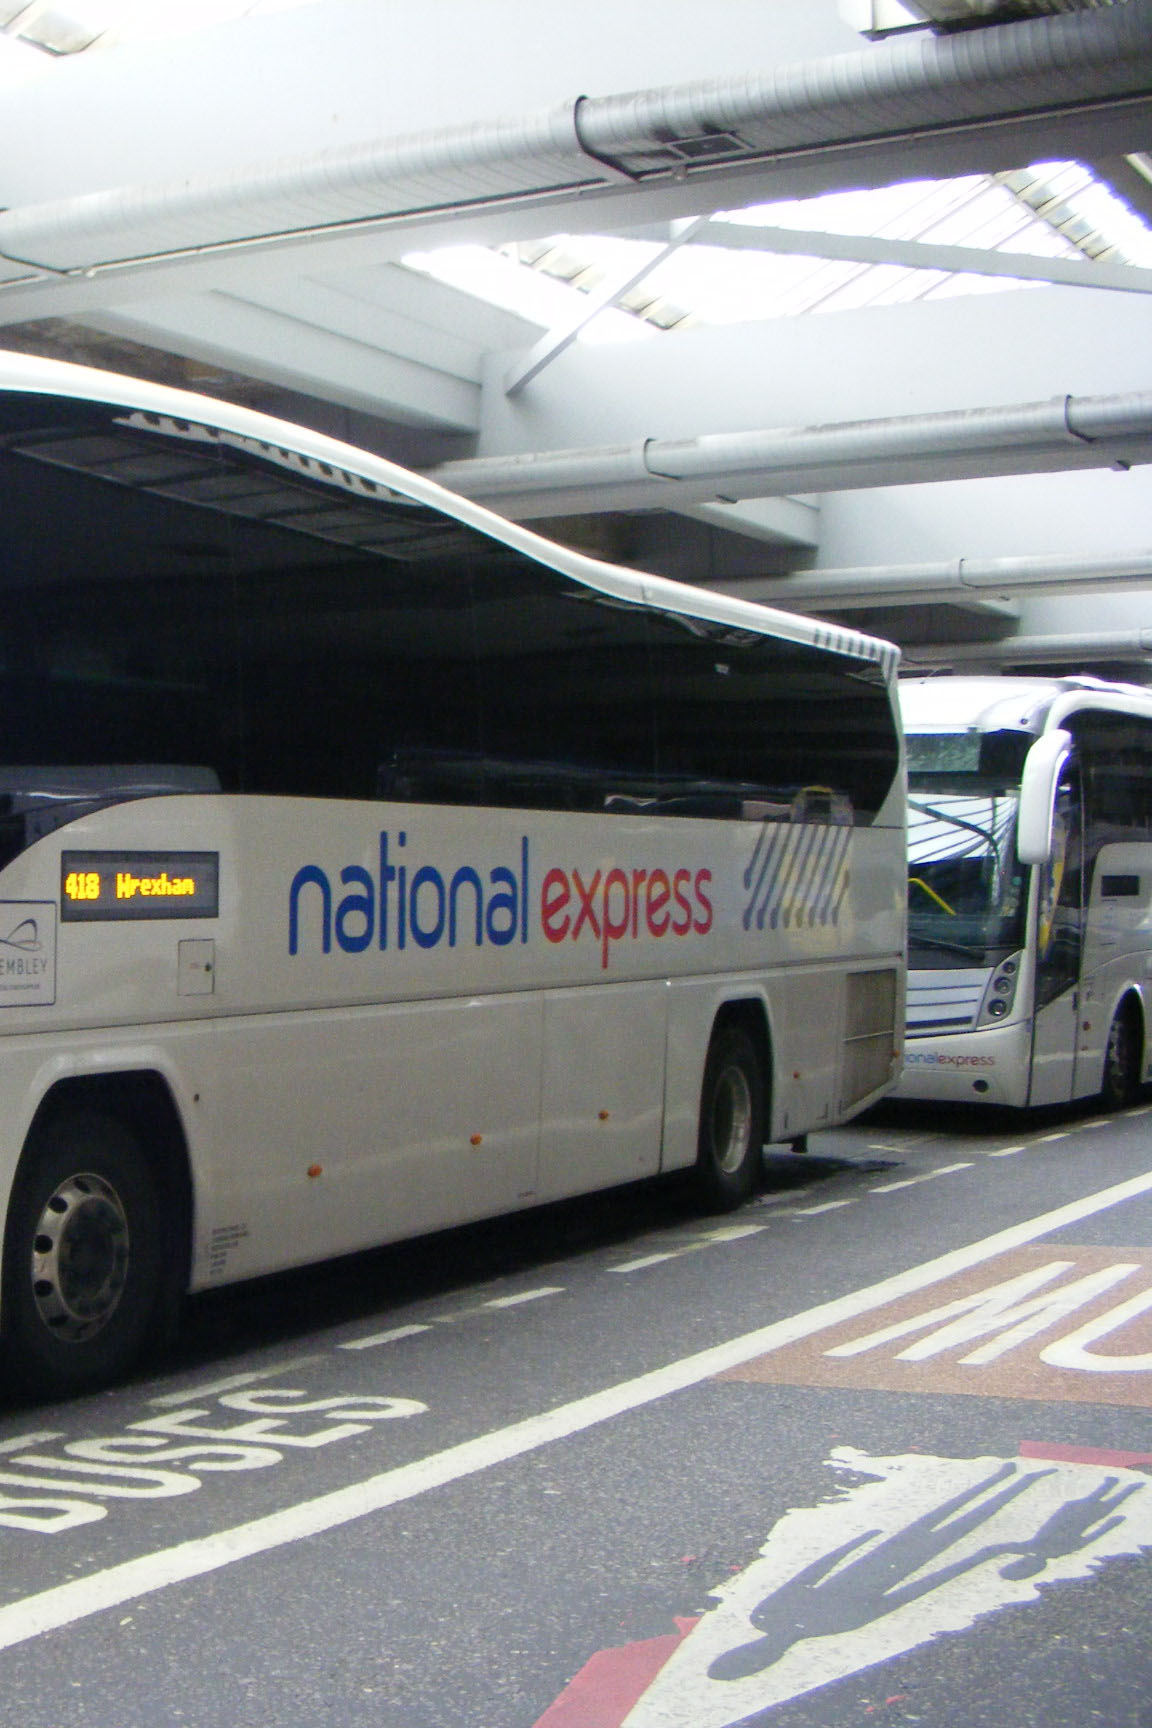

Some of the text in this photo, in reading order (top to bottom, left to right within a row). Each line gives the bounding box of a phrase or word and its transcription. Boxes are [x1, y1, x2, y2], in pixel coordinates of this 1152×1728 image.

[65, 872, 195, 900] 418 Wrexham
[289, 831, 713, 969] national express
[938, 1054, 996, 1068] express
